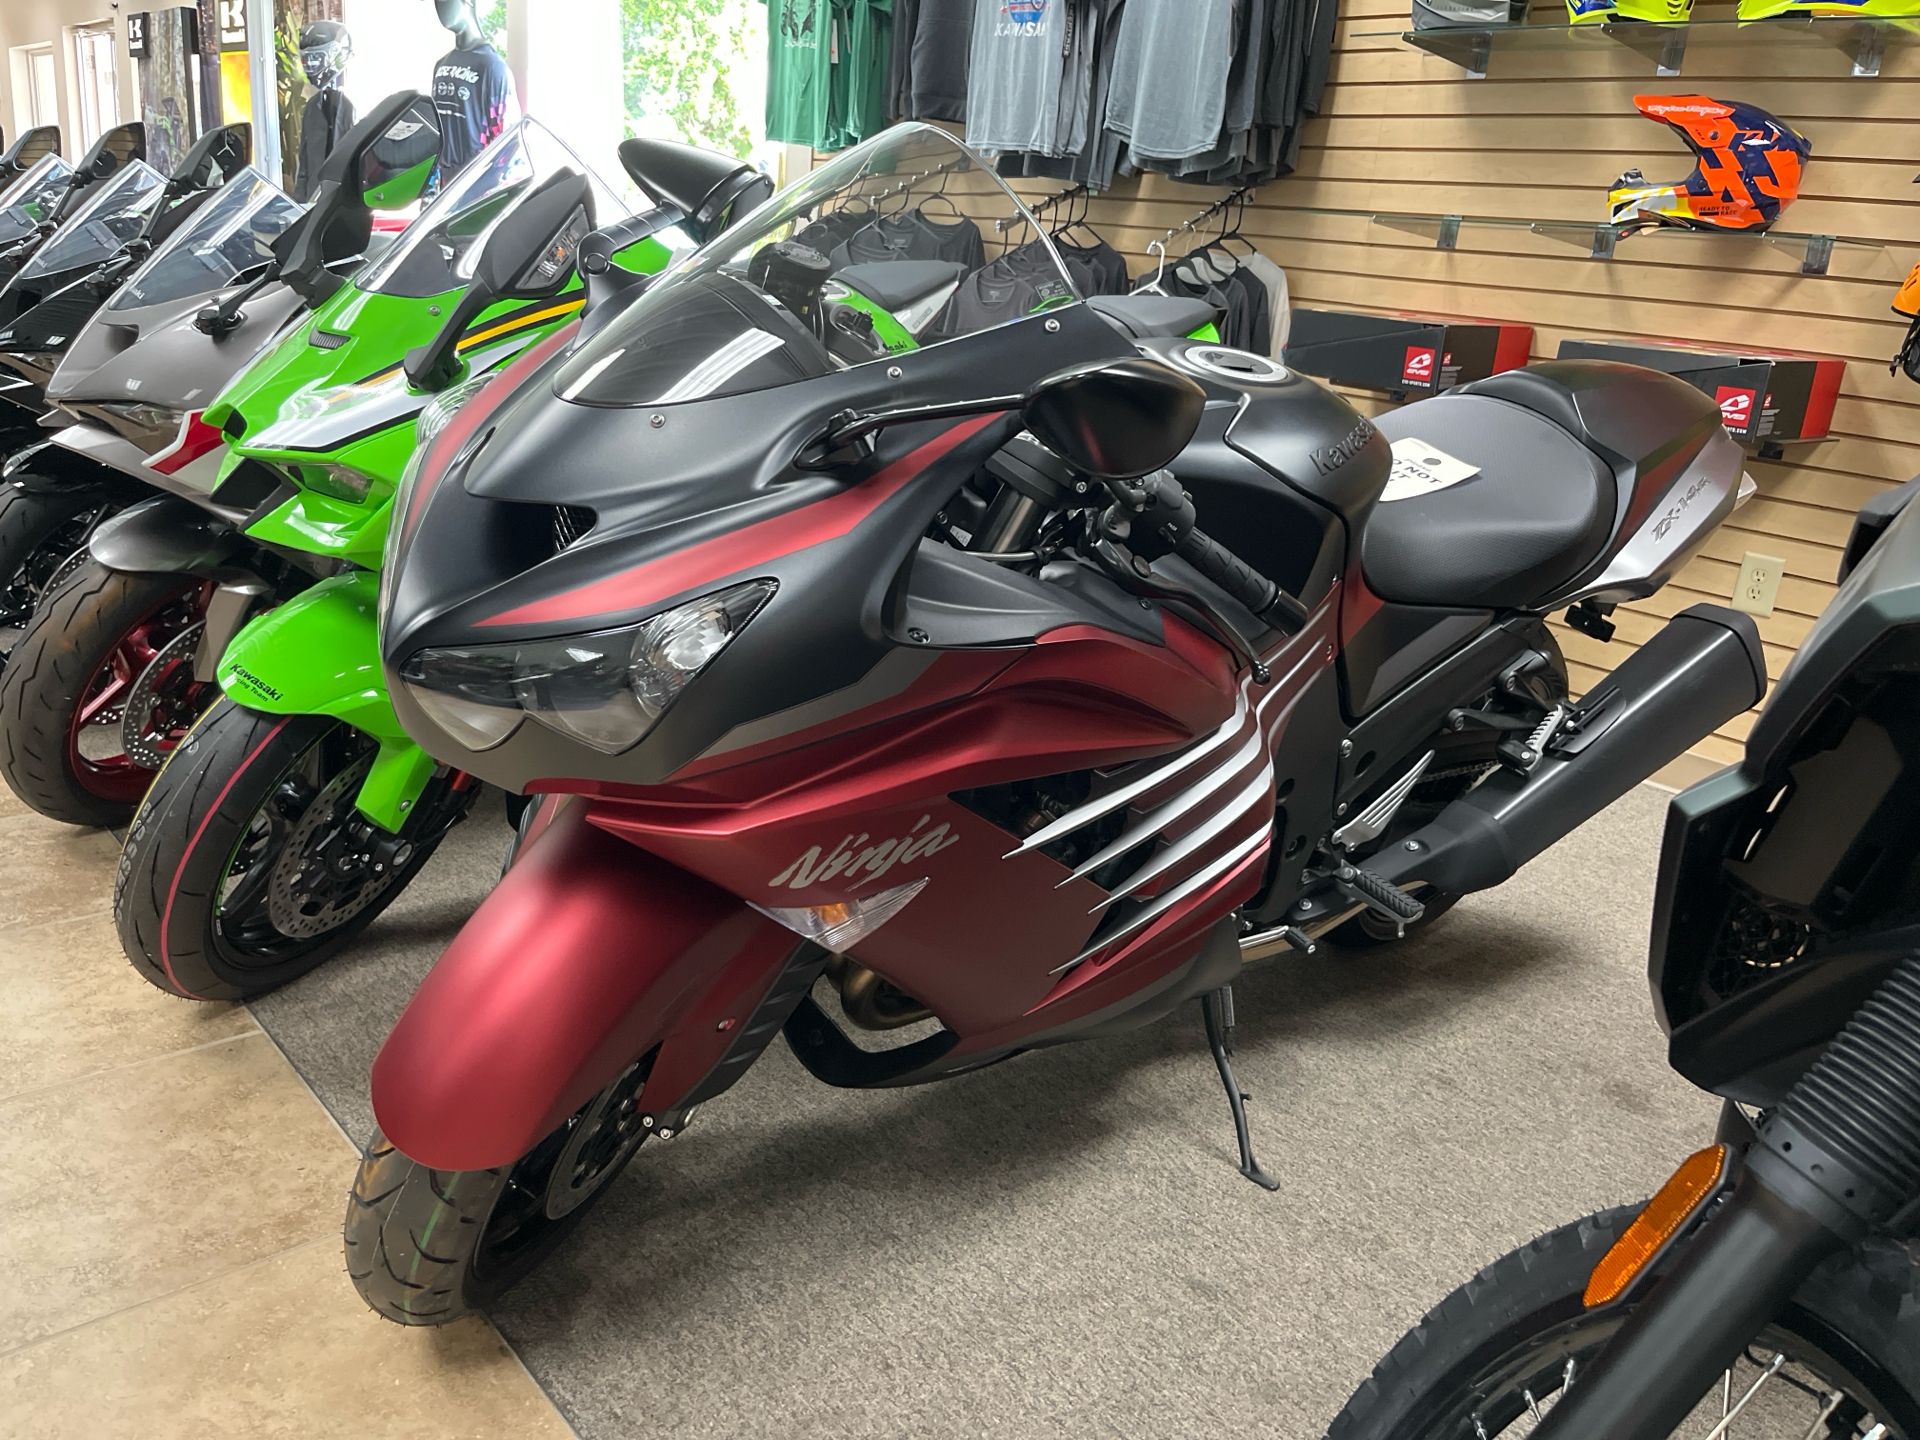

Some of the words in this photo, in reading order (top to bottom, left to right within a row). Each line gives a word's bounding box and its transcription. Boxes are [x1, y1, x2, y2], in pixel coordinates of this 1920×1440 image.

[993, 22, 1047, 37] KAWASA
[1406, 368, 1430, 376] EVS
[1391, 470, 1411, 479] IT
[1404, 466, 1443, 484] NOT
[229, 663, 284, 702] Kawasaki
[250, 686, 269, 702] Team
[768, 814, 960, 892] Ninja
